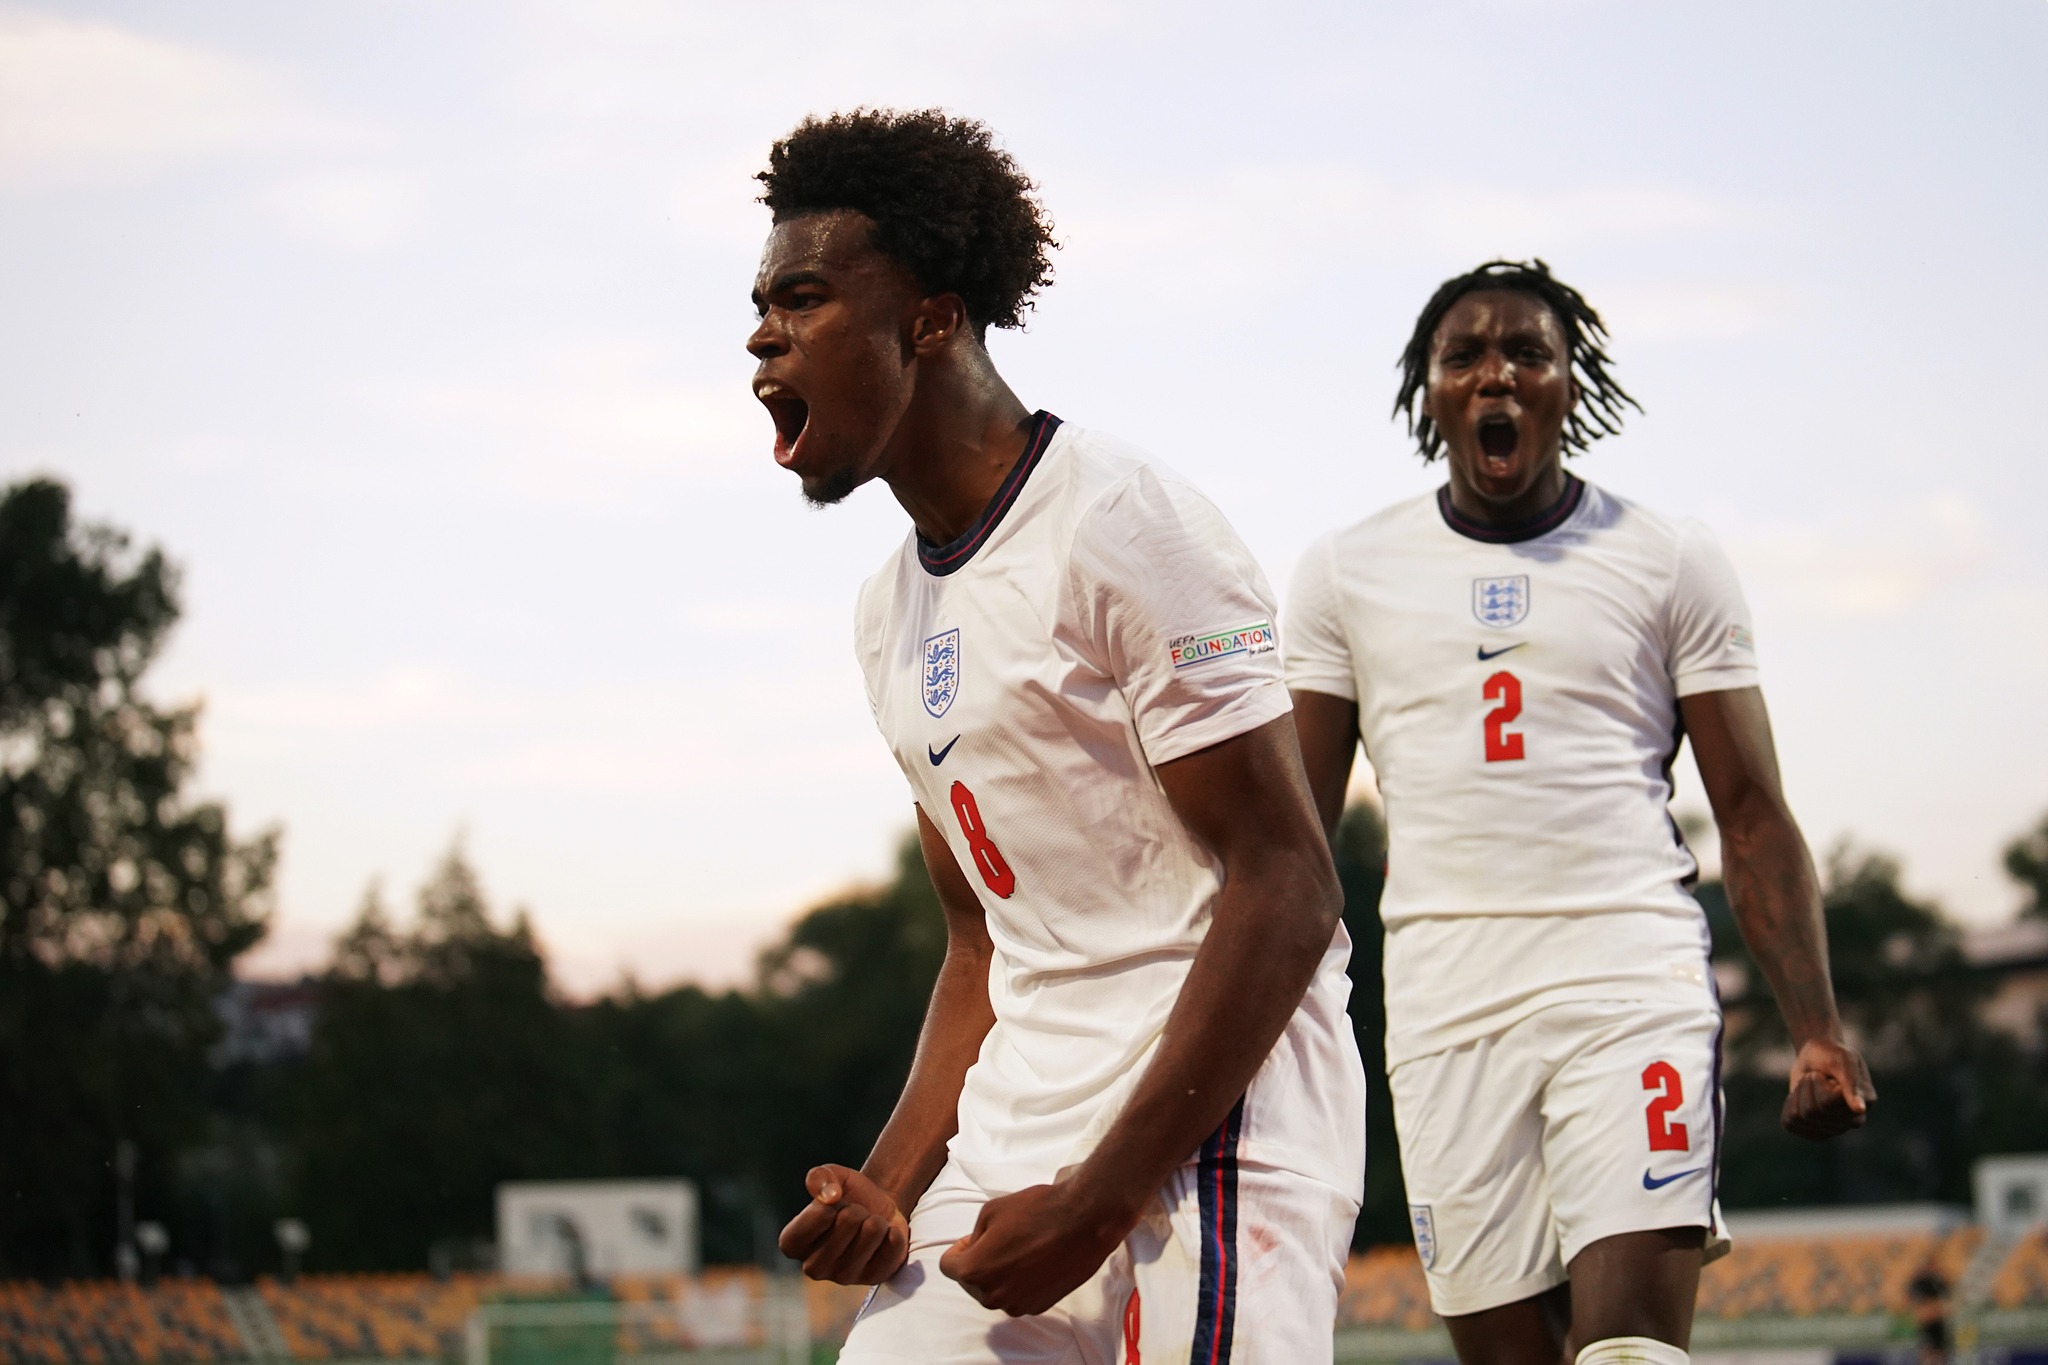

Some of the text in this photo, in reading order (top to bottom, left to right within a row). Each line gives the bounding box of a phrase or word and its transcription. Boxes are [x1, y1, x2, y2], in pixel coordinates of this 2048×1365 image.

[1169, 635, 1195, 649] UEFA
[1482, 670, 1525, 763] 2
[950, 780, 1016, 899] 8
[1641, 1060, 1689, 1152] 2
